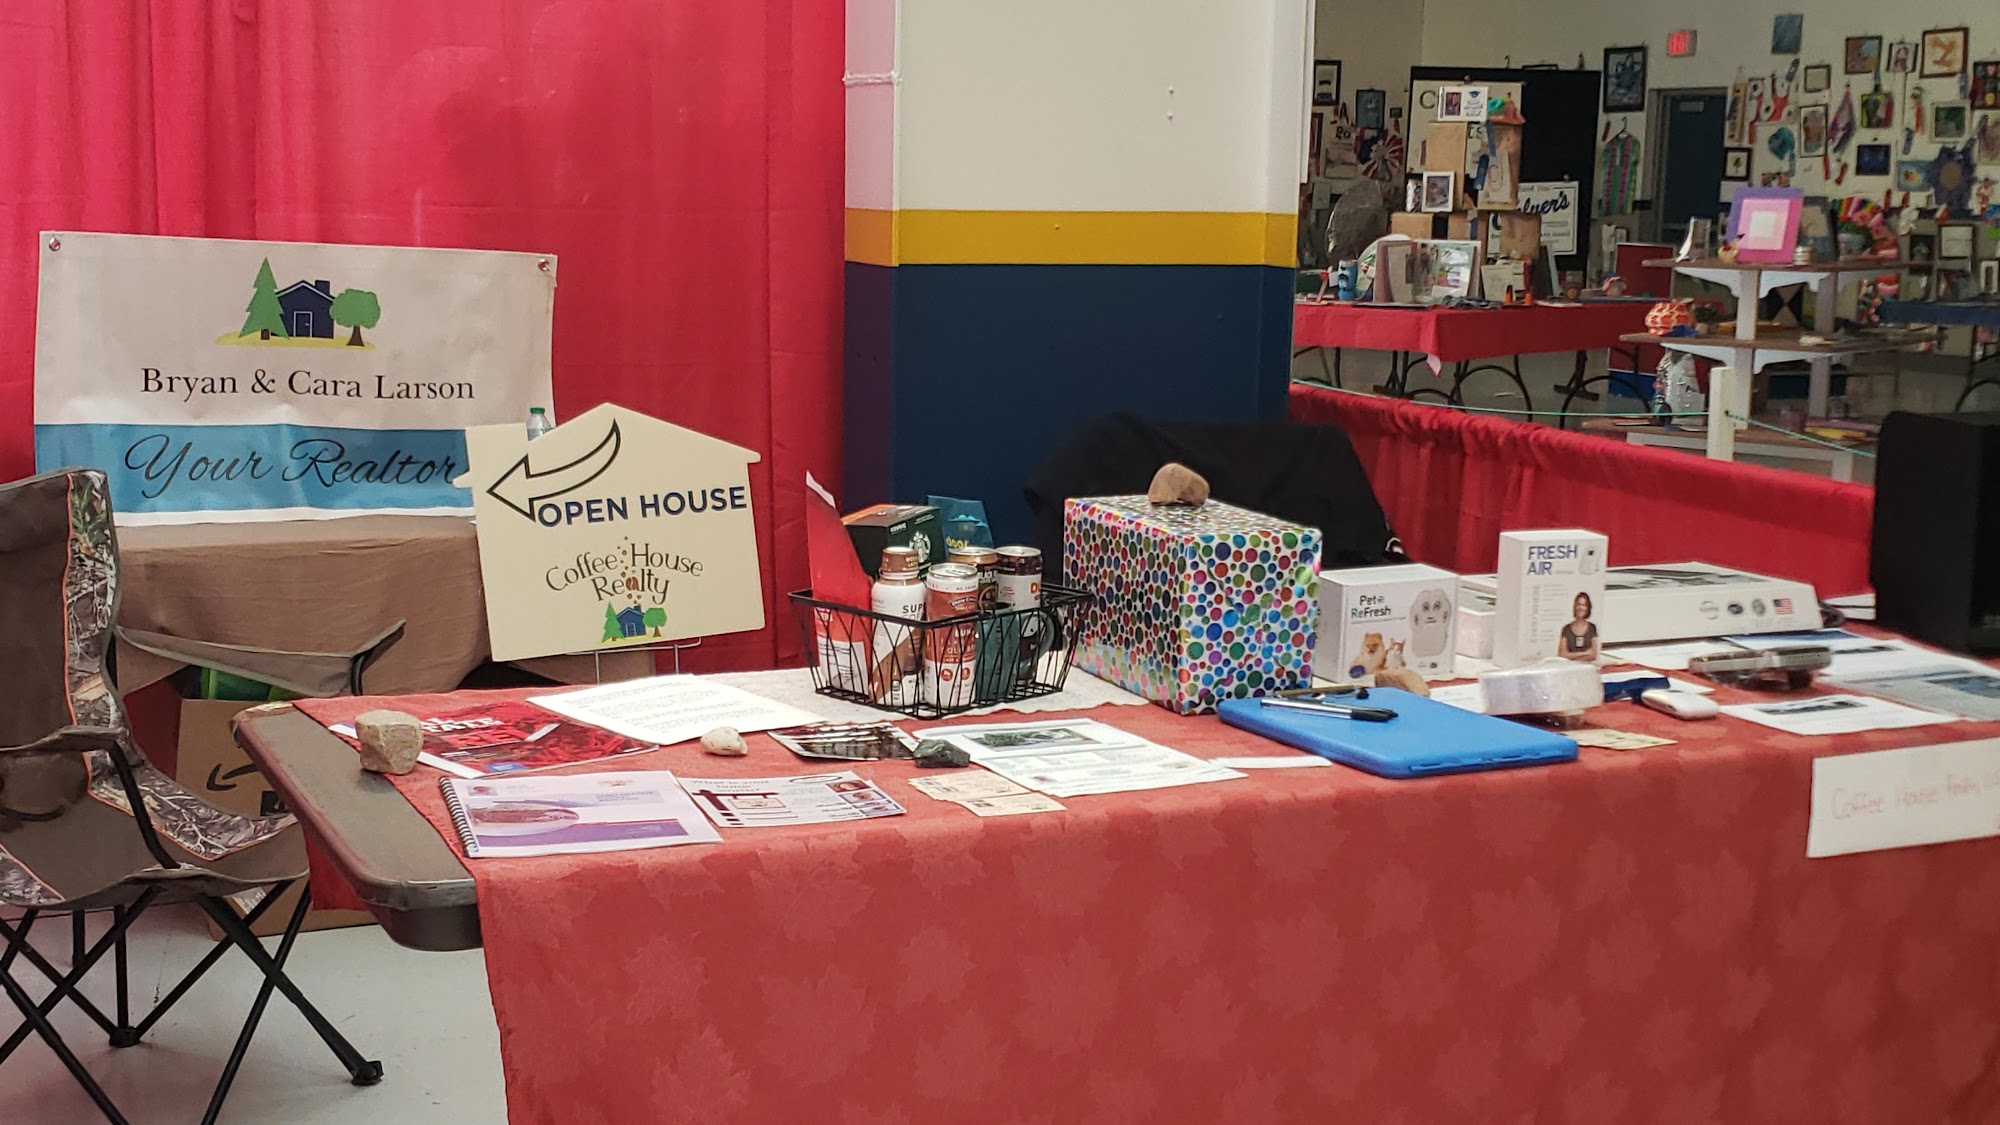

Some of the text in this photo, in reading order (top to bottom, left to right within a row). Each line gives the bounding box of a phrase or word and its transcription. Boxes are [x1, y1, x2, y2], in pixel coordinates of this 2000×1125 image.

[140, 367, 475, 403] Bryan & Cara Larson
[124, 433, 273, 500] Your
[537, 485, 748, 528] OPEN HOUSE
[545, 543, 704, 592] Coffee House
[1526, 561, 1552, 576] AIR
[1527, 544, 1578, 560] FRESH
[590, 568, 670, 605] Realty
[1359, 595, 1377, 606] Pet
[1350, 604, 1392, 620] ReFresh
